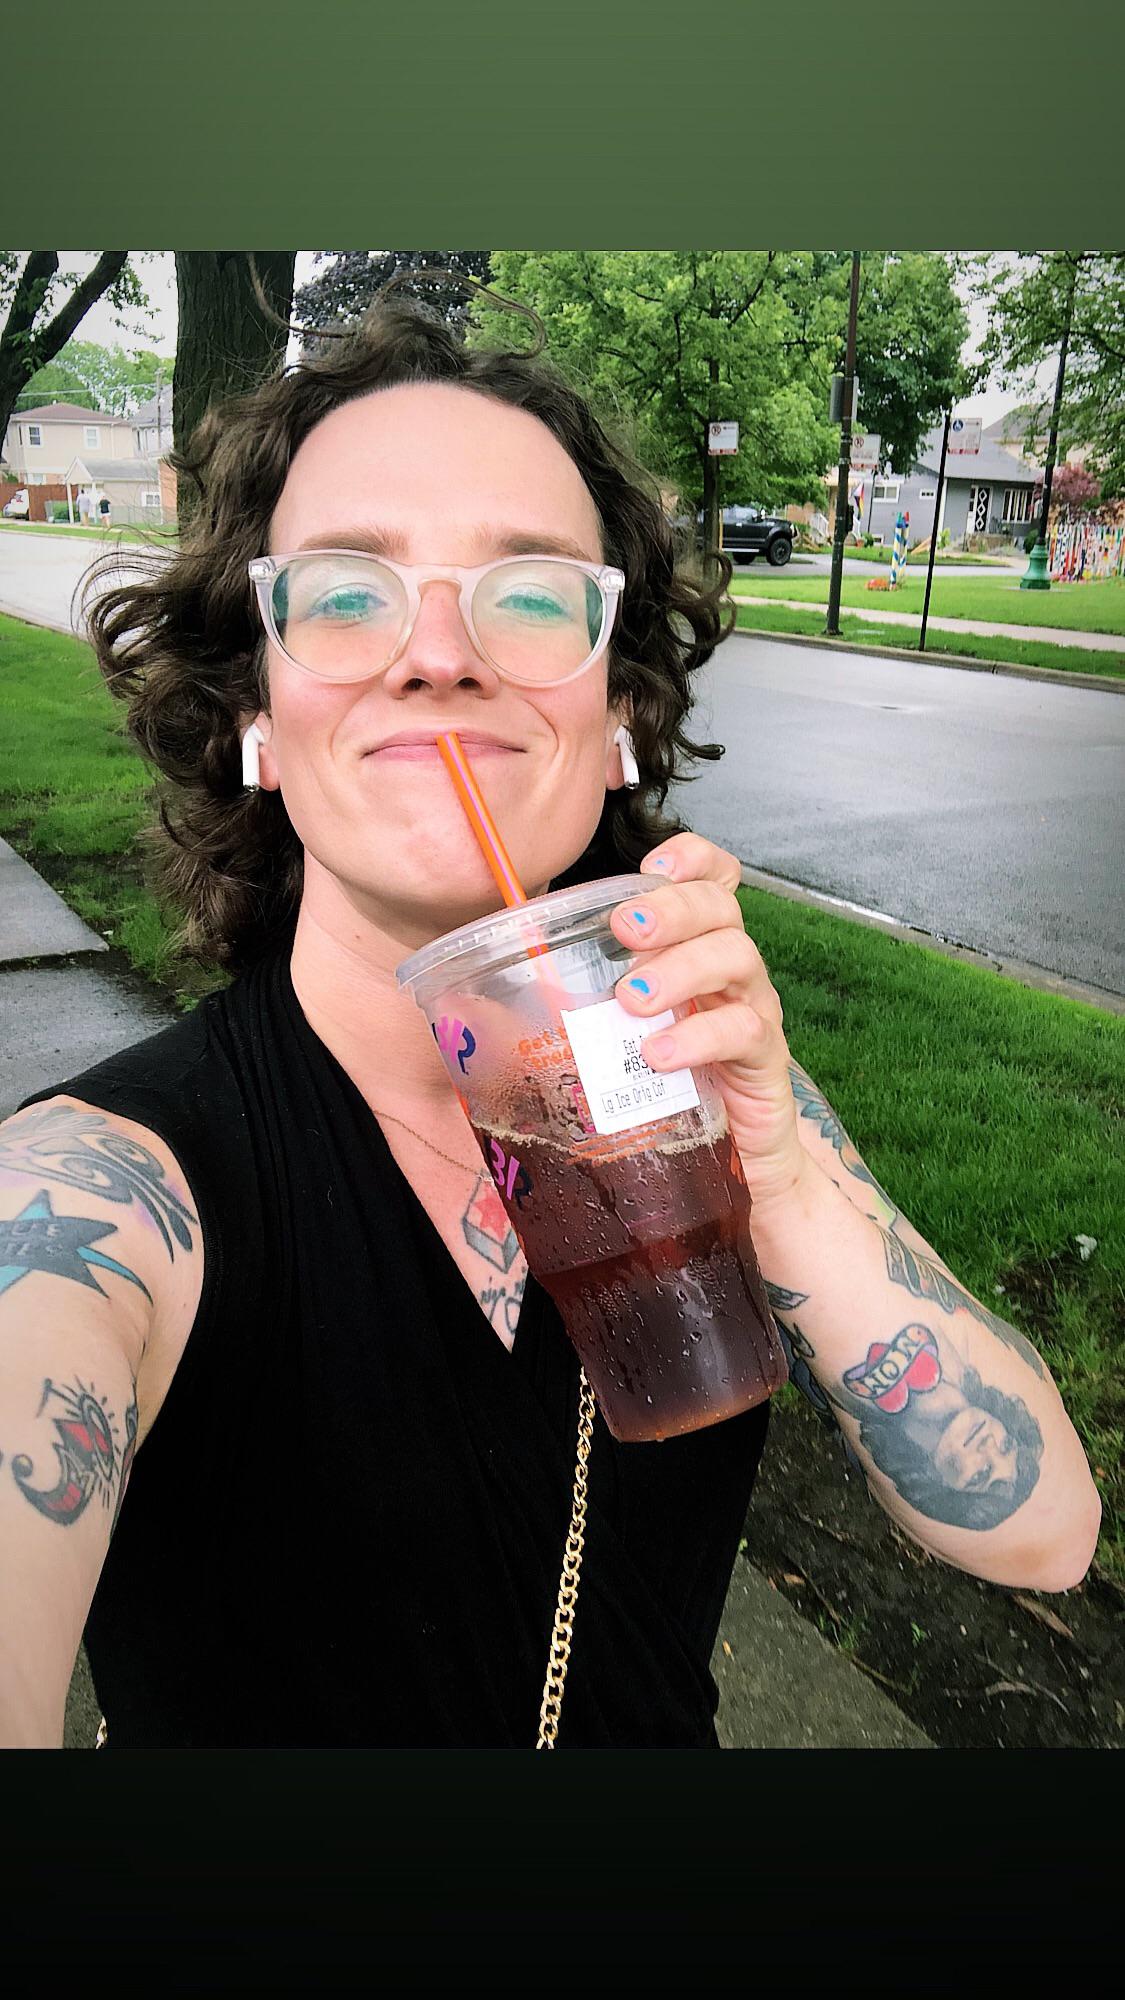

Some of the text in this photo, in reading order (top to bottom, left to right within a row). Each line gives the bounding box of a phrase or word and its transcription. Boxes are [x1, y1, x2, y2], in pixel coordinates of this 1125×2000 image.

[622, 1039, 638, 1056] Eat
[601, 1096, 614, 1114] Lg
[615, 1093, 631, 1110] Ice
[633, 1085, 652, 1104] Orig
